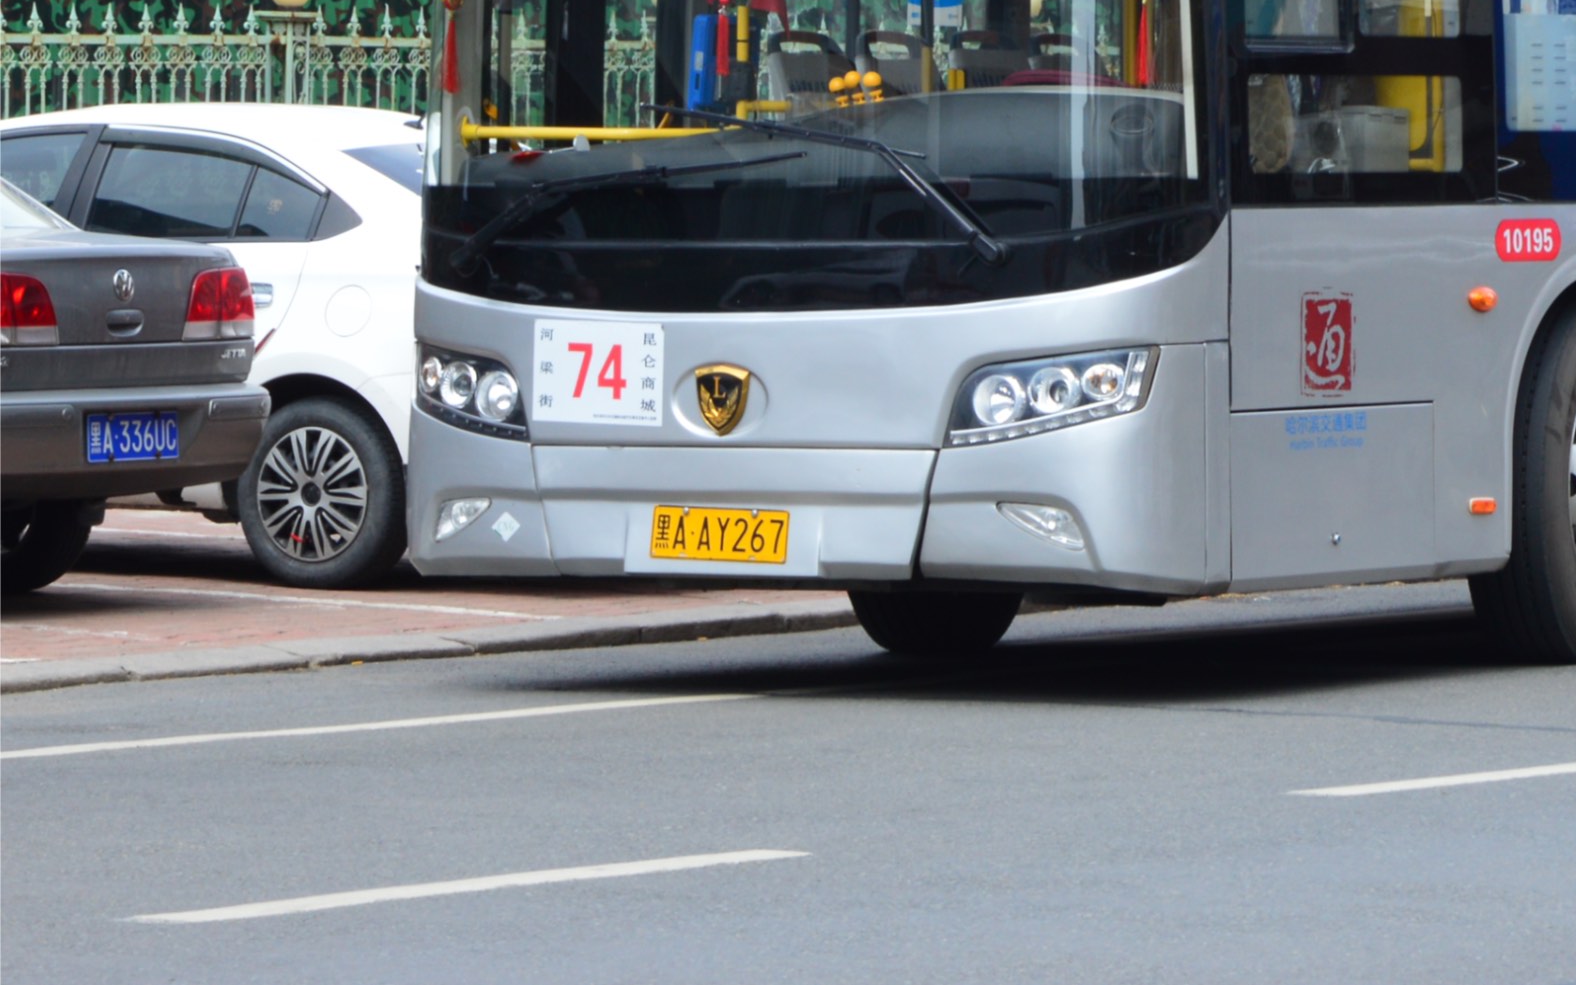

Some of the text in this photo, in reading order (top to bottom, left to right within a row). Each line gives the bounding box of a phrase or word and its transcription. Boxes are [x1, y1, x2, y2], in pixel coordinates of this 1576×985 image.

[1503, 227, 1554, 254] 10195
[568, 342, 627, 400] 74
[640, 332, 657, 412] 昆仑商城
